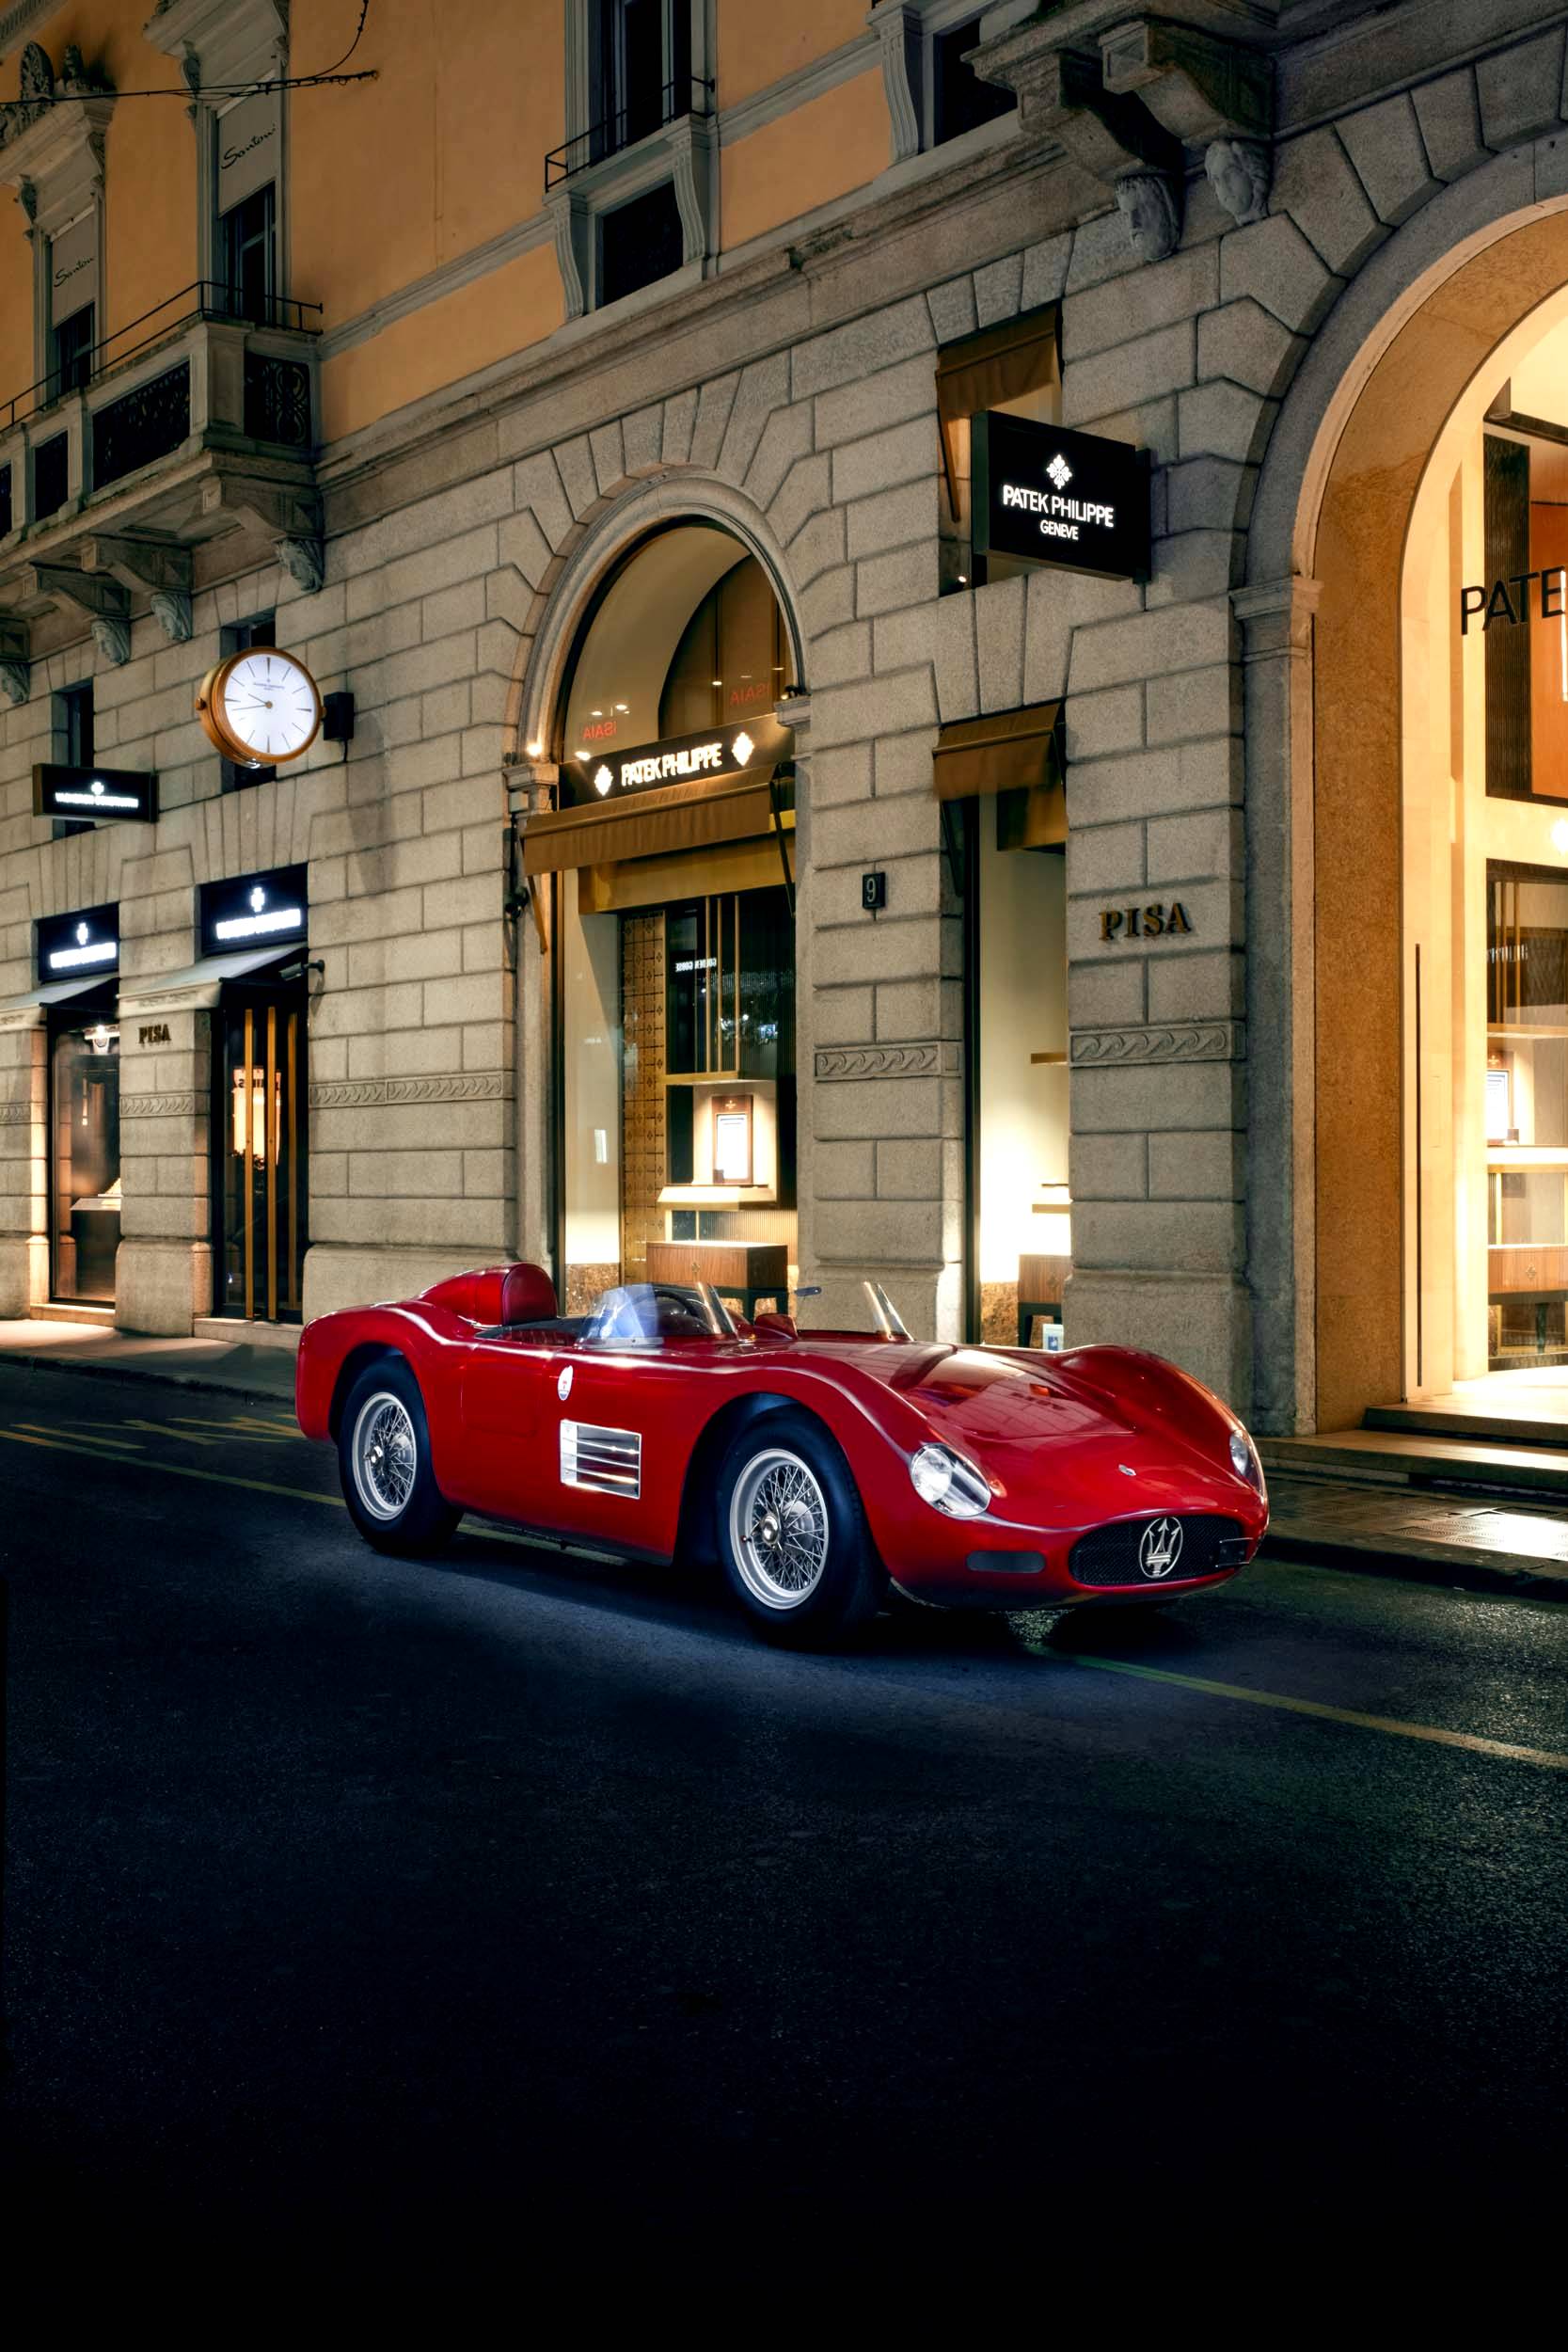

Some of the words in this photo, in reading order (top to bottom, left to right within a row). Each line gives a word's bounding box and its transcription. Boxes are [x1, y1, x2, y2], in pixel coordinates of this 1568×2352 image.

[1003, 484, 1049, 514] PATEK
[1052, 495, 1115, 528] PHILIPPE
[1039, 519, 1079, 541] GENEVE
[621, 757, 663, 787] PATEK
[662, 742, 722, 777] PHILIPPE
[866, 877, 877, 903] 9
[1099, 902, 1193, 942] PISA
[138, 1024, 171, 1045] PISA
